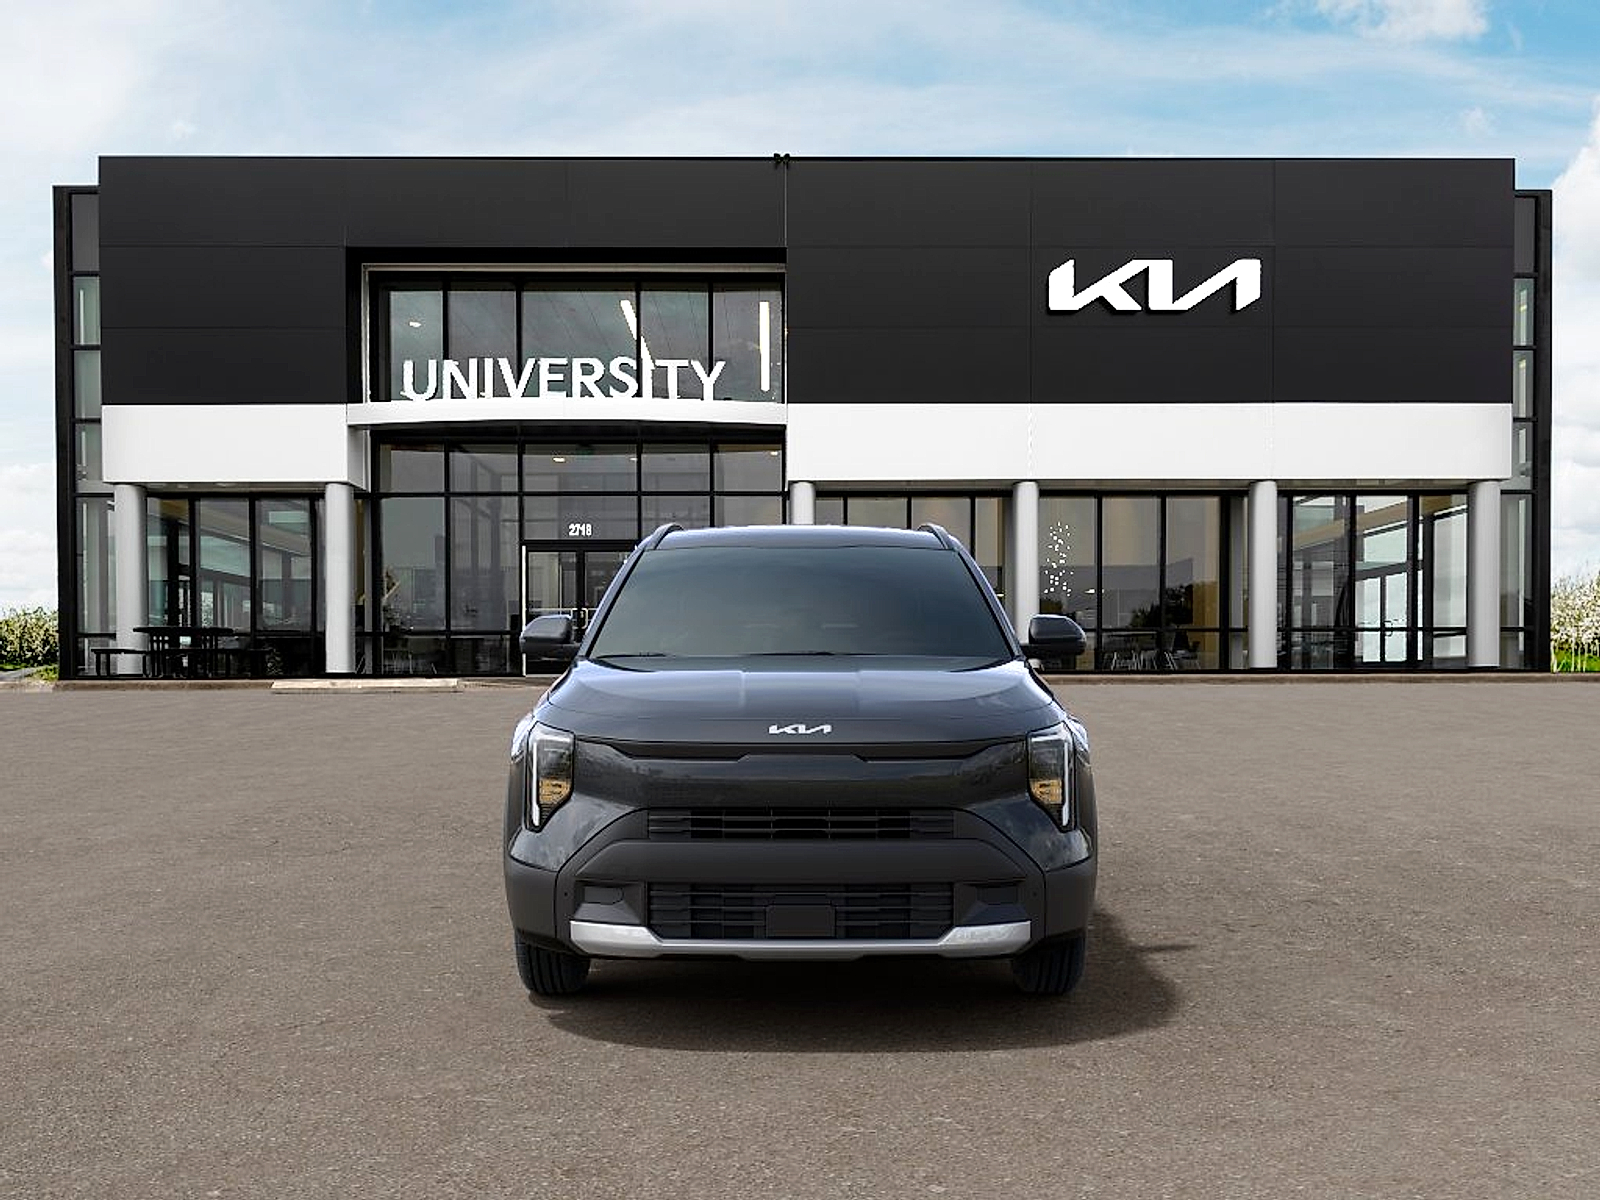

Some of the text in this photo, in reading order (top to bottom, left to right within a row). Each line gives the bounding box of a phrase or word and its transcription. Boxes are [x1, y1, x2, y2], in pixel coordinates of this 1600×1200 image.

[1048, 258, 1261, 311] KIA
[402, 356, 726, 401] UNIVERSITY
[568, 523, 592, 536] 2718
[769, 724, 832, 734] KIA
